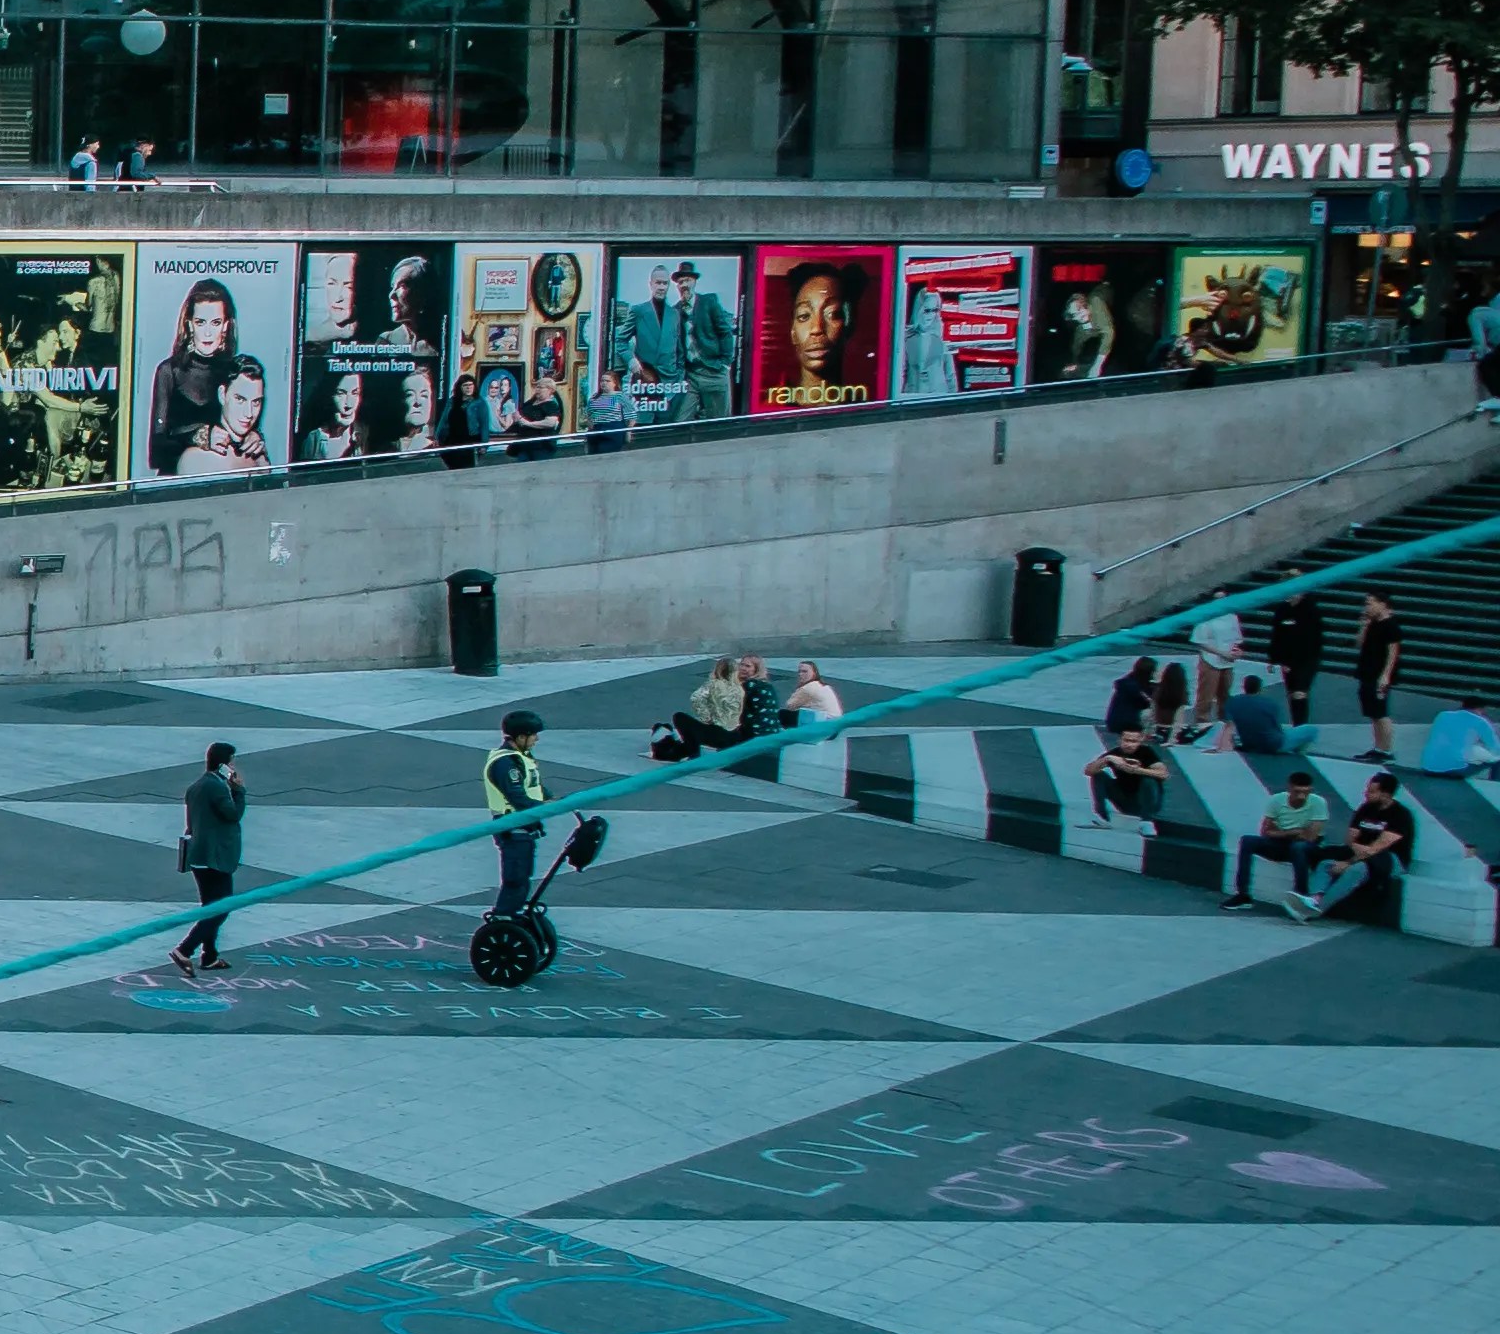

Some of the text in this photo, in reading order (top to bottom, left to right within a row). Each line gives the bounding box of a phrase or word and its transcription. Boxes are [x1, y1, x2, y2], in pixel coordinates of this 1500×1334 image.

[1221, 141, 1433, 180] WAYNES
[154, 260, 279, 274] MANDOMSPROVET
[332, 341, 411, 354] Undkom ensam
[327, 359, 415, 372] Tänk om om bara
[84, 366, 118, 390] VI
[767, 381, 867, 404] random
[681, 1110, 991, 1199] LOVE
[927, 1117, 1190, 1213] OTHERS
[134, 1157, 340, 1187] ÄLSKA
[141, 1184, 285, 1208] MAN
[290, 1187, 420, 1212] KAN
